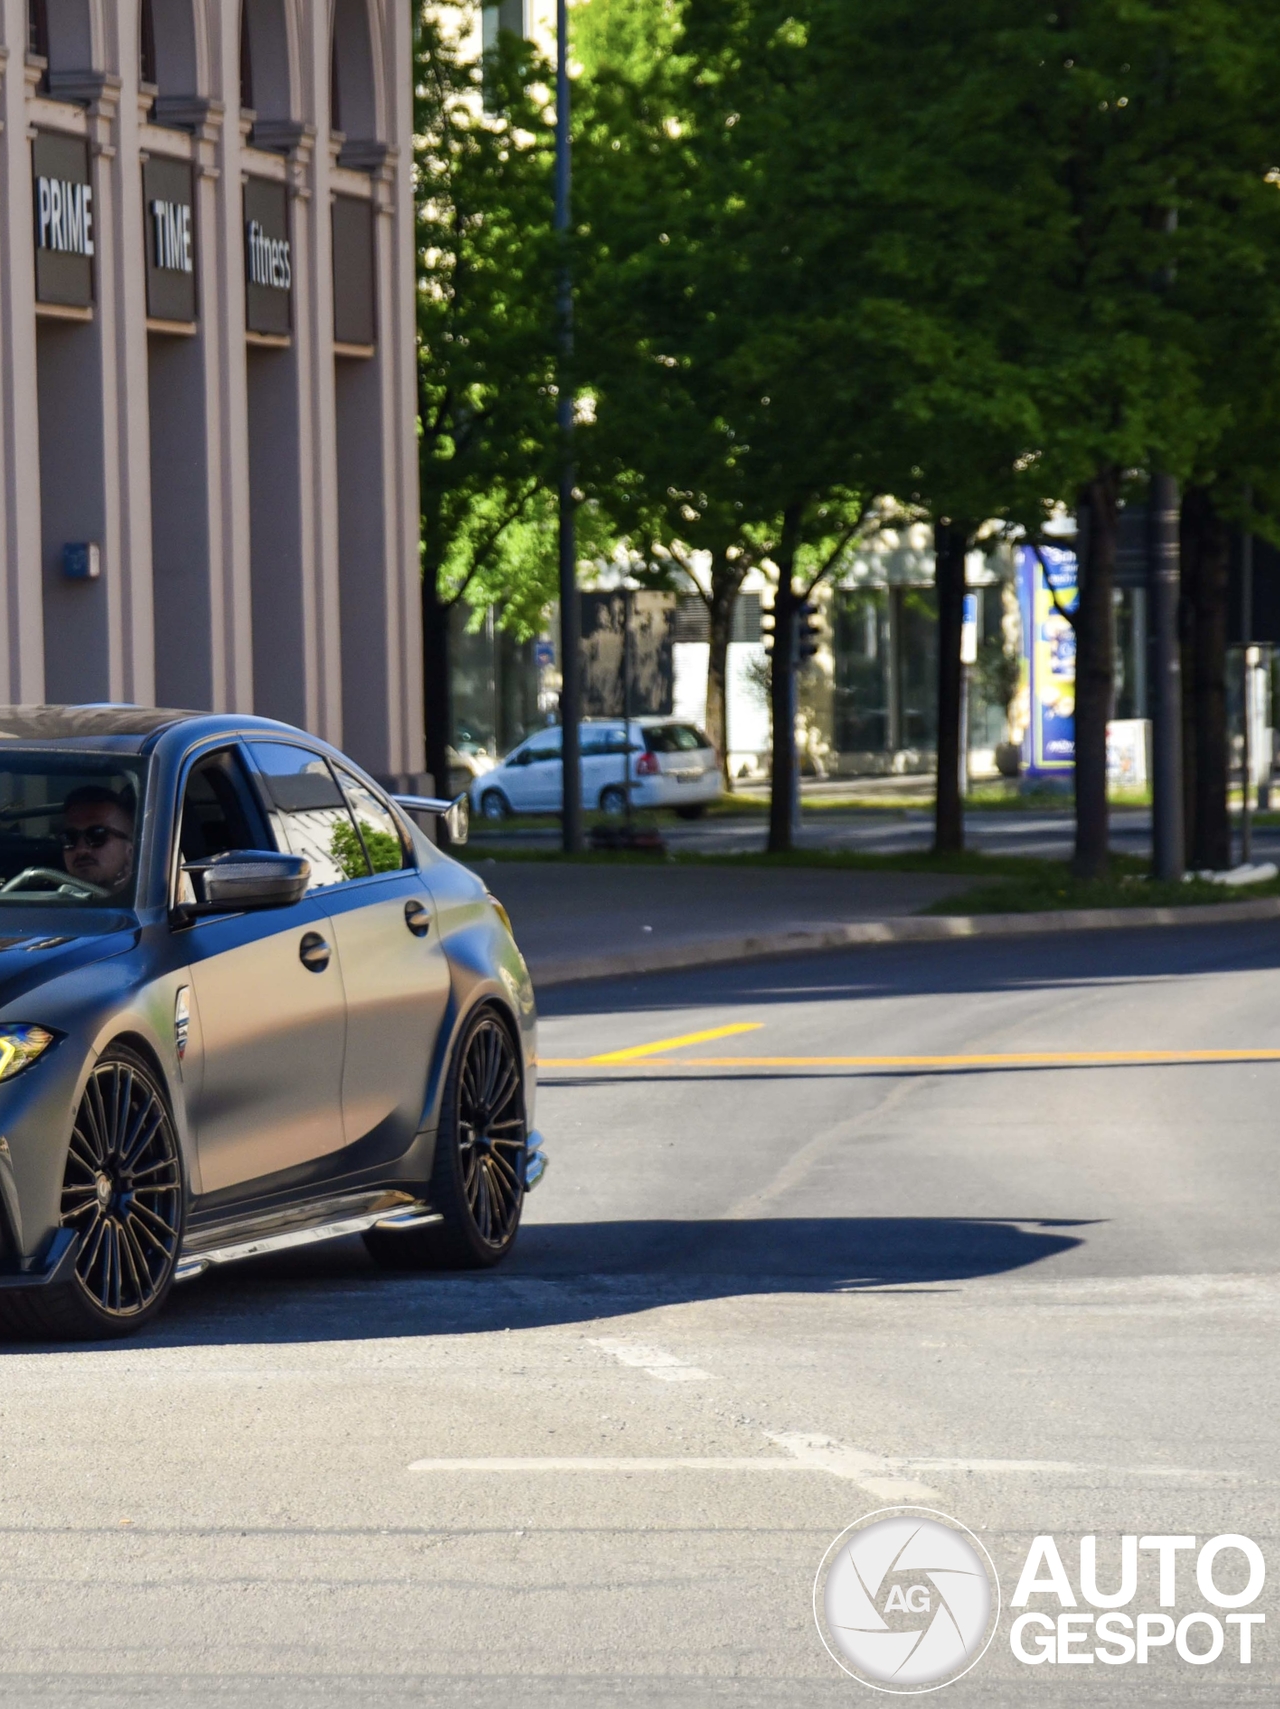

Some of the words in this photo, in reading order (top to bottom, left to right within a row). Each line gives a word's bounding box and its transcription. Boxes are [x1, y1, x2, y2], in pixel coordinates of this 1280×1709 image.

[37, 176, 95, 256] PRIME
[152, 200, 193, 273] TIME
[249, 220, 291, 288] fitness
